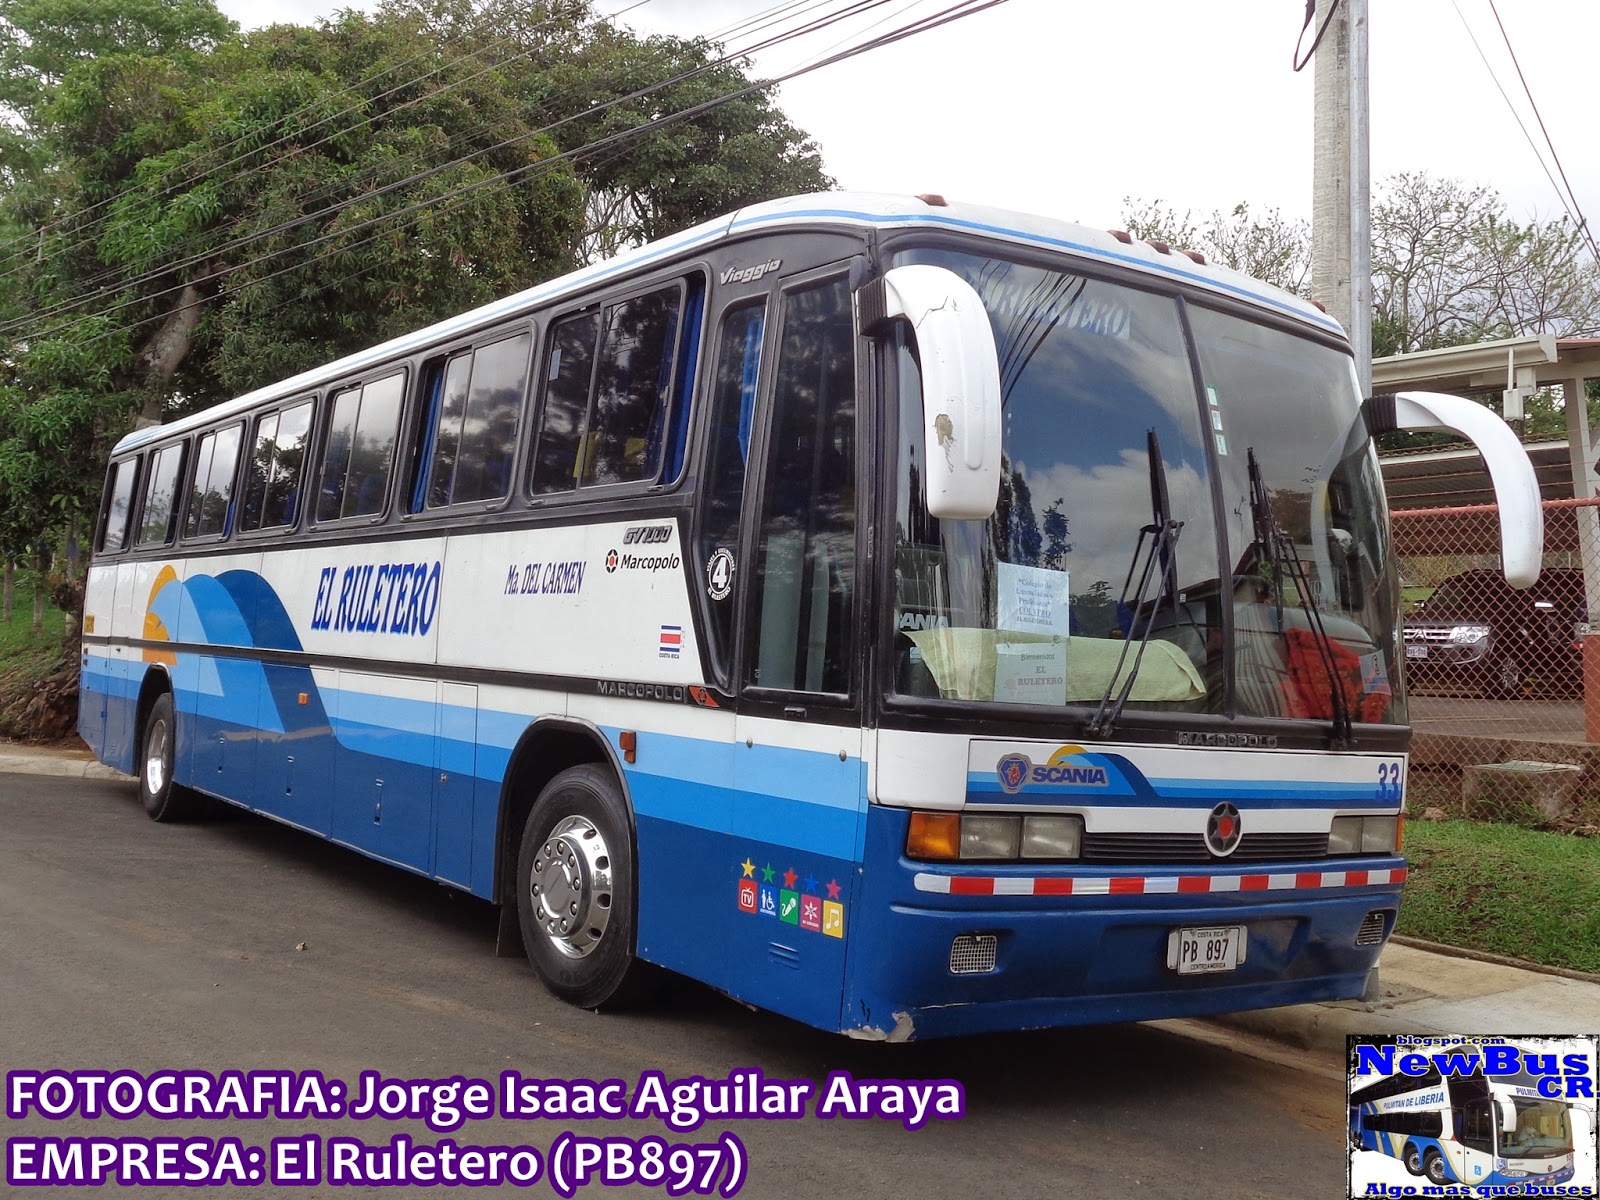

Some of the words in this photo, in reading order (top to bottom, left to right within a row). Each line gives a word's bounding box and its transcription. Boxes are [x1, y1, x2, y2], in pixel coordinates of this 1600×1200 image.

[720, 259, 782, 286] Viaggio
[622, 524, 673, 544] GV1000
[620, 553, 680, 573] Marcopolo
[712, 556, 727, 589] 4
[520, 563, 542, 595] DEL
[542, 560, 586, 595] CARMEN
[311, 566, 337, 632] EL
[334, 560, 441, 637] RULETERO
[899, 612, 949, 630] ANIA
[1020, 653, 1055, 661] Bienvenidos
[1035, 665, 1047, 674] EL
[597, 680, 684, 701] MARCOPOLO
[1017, 676, 1063, 687] RULETERO
[1177, 731, 1278, 749] MARCOPOLO
[1032, 767, 1106, 784] SCANIA
[1375, 762, 1400, 804] 33
[743, 892, 752, 905] TV
[1213, 930, 1224, 938] RICA
[1183, 940, 1198, 963] PB
[1206, 938, 1230, 961] 897
